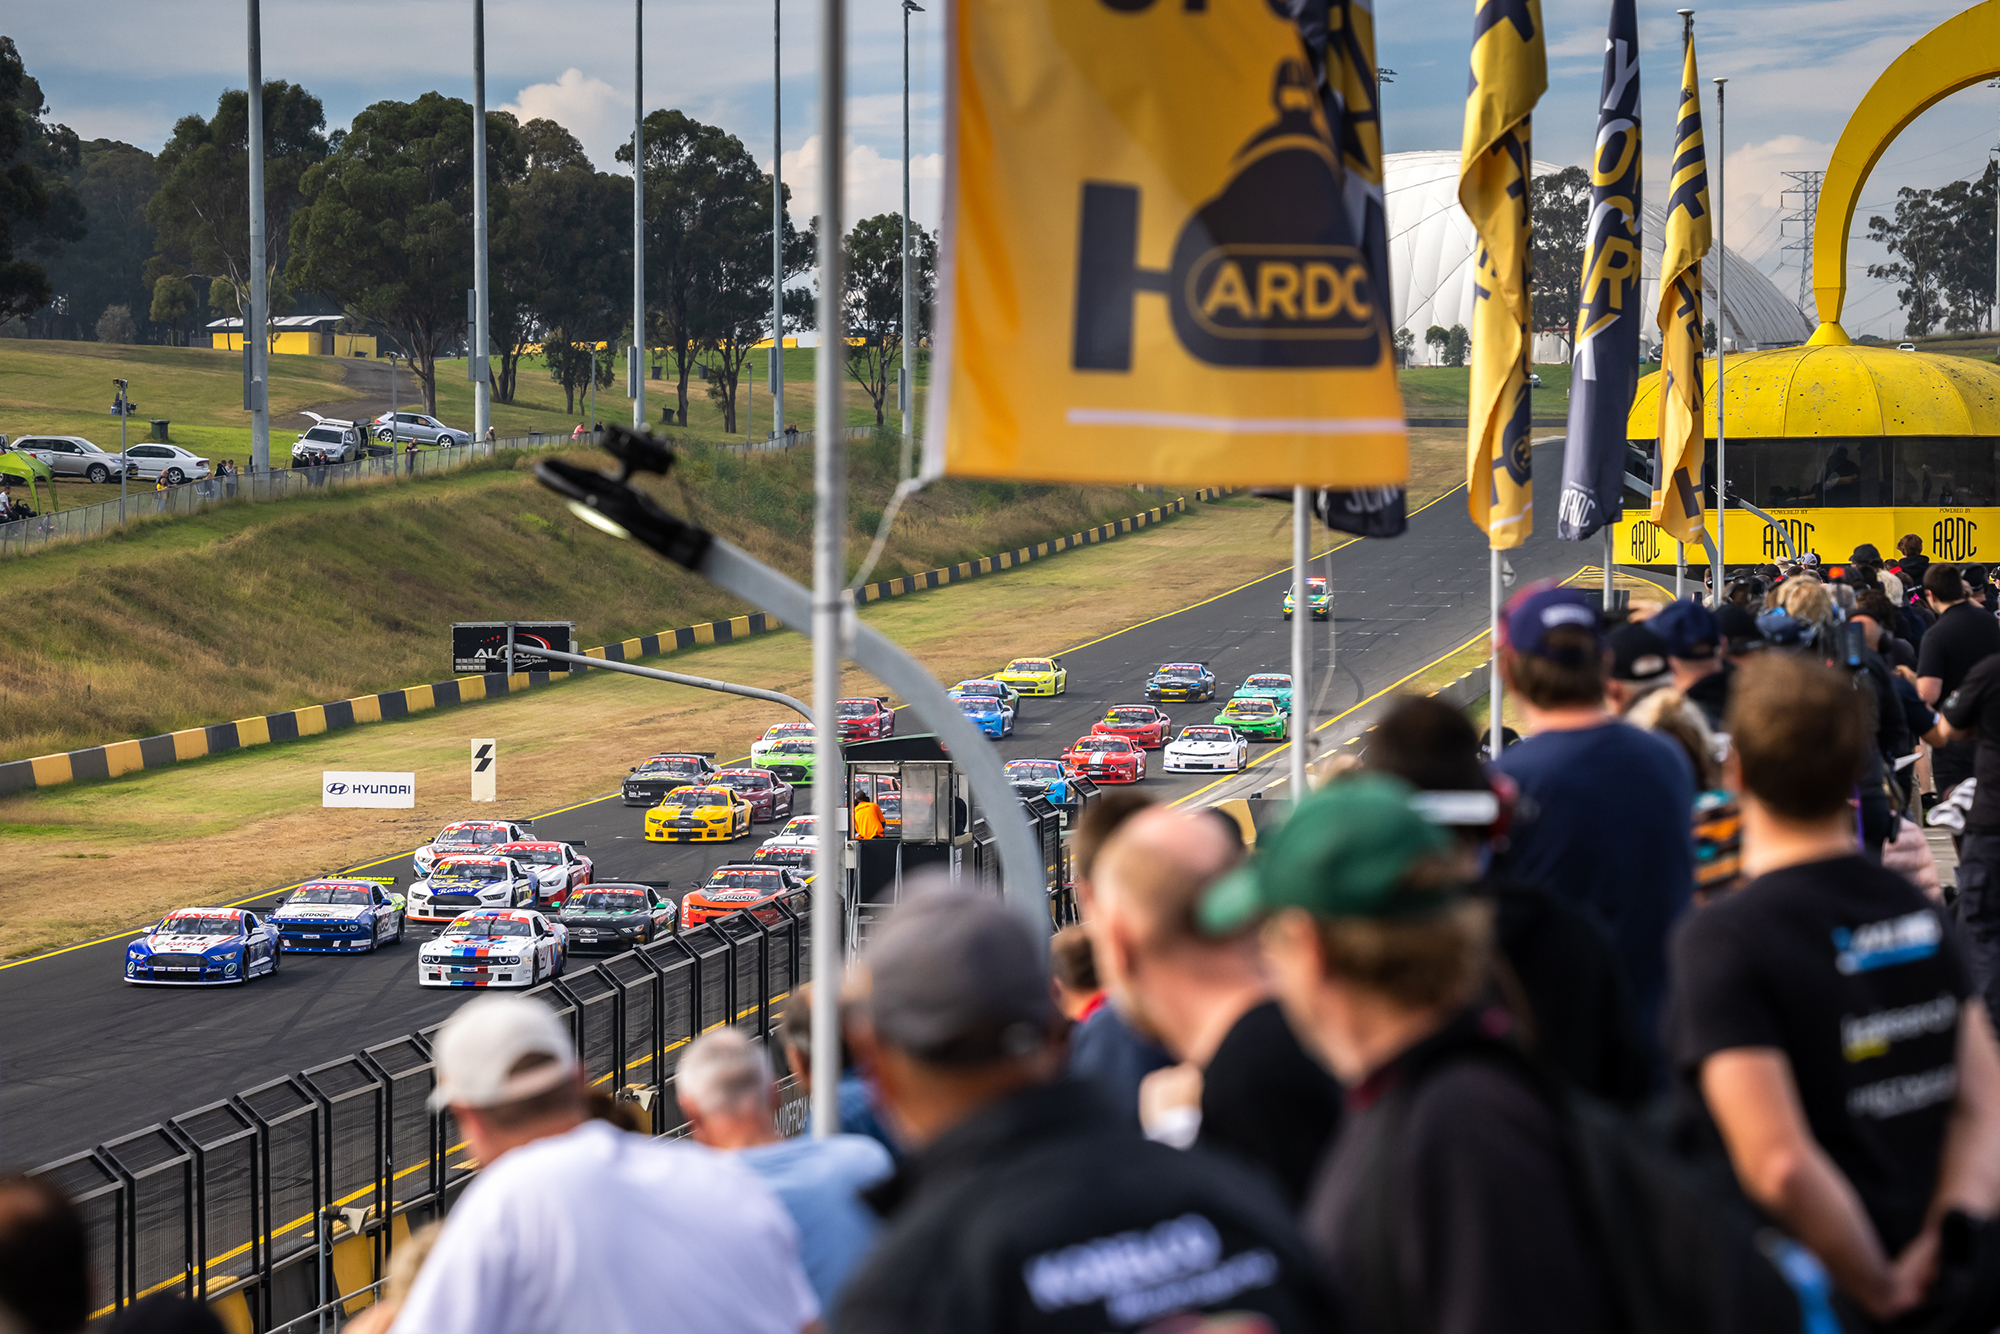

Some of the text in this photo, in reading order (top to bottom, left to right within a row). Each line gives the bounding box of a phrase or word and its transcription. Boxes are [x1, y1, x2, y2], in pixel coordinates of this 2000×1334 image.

[1631, 519, 1660, 563] ARDC
[1763, 518, 1815, 560] ARDC
[1933, 517, 1978, 561] ARDC
[352, 784, 411, 795] HYUNDAI
[437, 886, 474, 895] Racing
